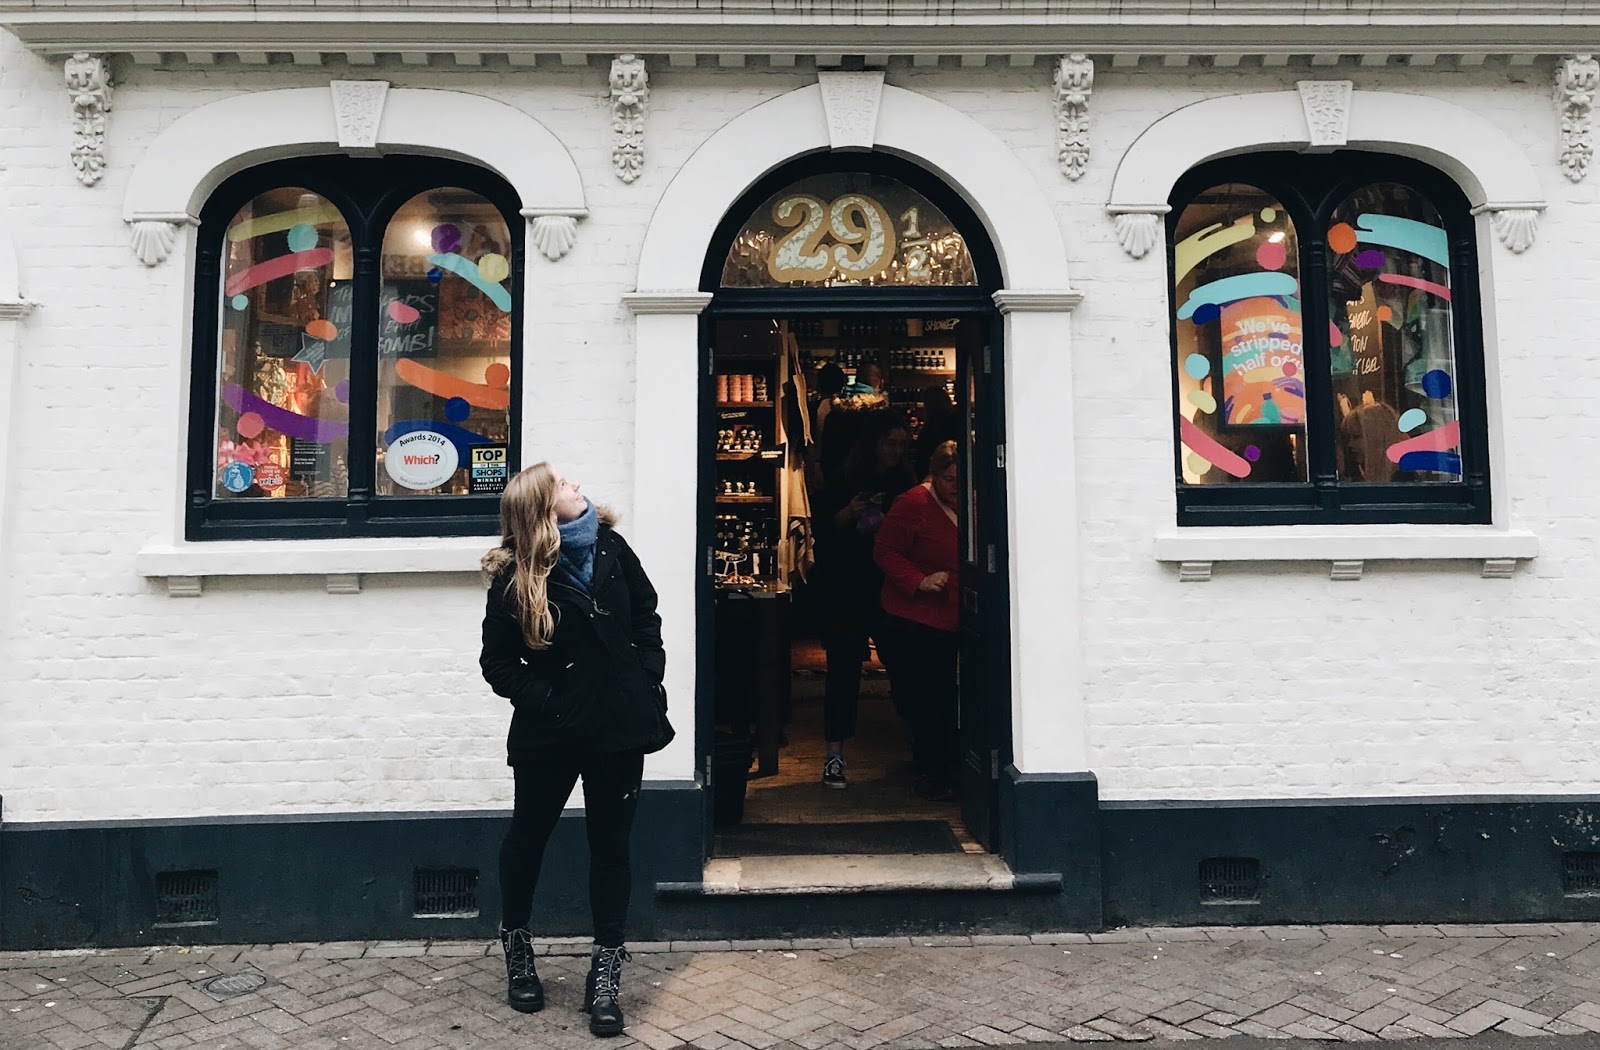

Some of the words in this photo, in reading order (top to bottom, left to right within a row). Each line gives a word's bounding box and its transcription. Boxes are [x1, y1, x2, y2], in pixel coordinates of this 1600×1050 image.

[769, 194, 896, 283] 29
[1236, 318, 1291, 336] We've
[1230, 335, 1303, 357] stripped
[1232, 351, 1266, 377] half
[399, 433, 426, 447] Awards
[428, 434, 446, 446] 2014
[403, 454, 440, 465] Which?
[475, 450, 503, 461] TOP
[475, 469, 503, 477] SHOPS
